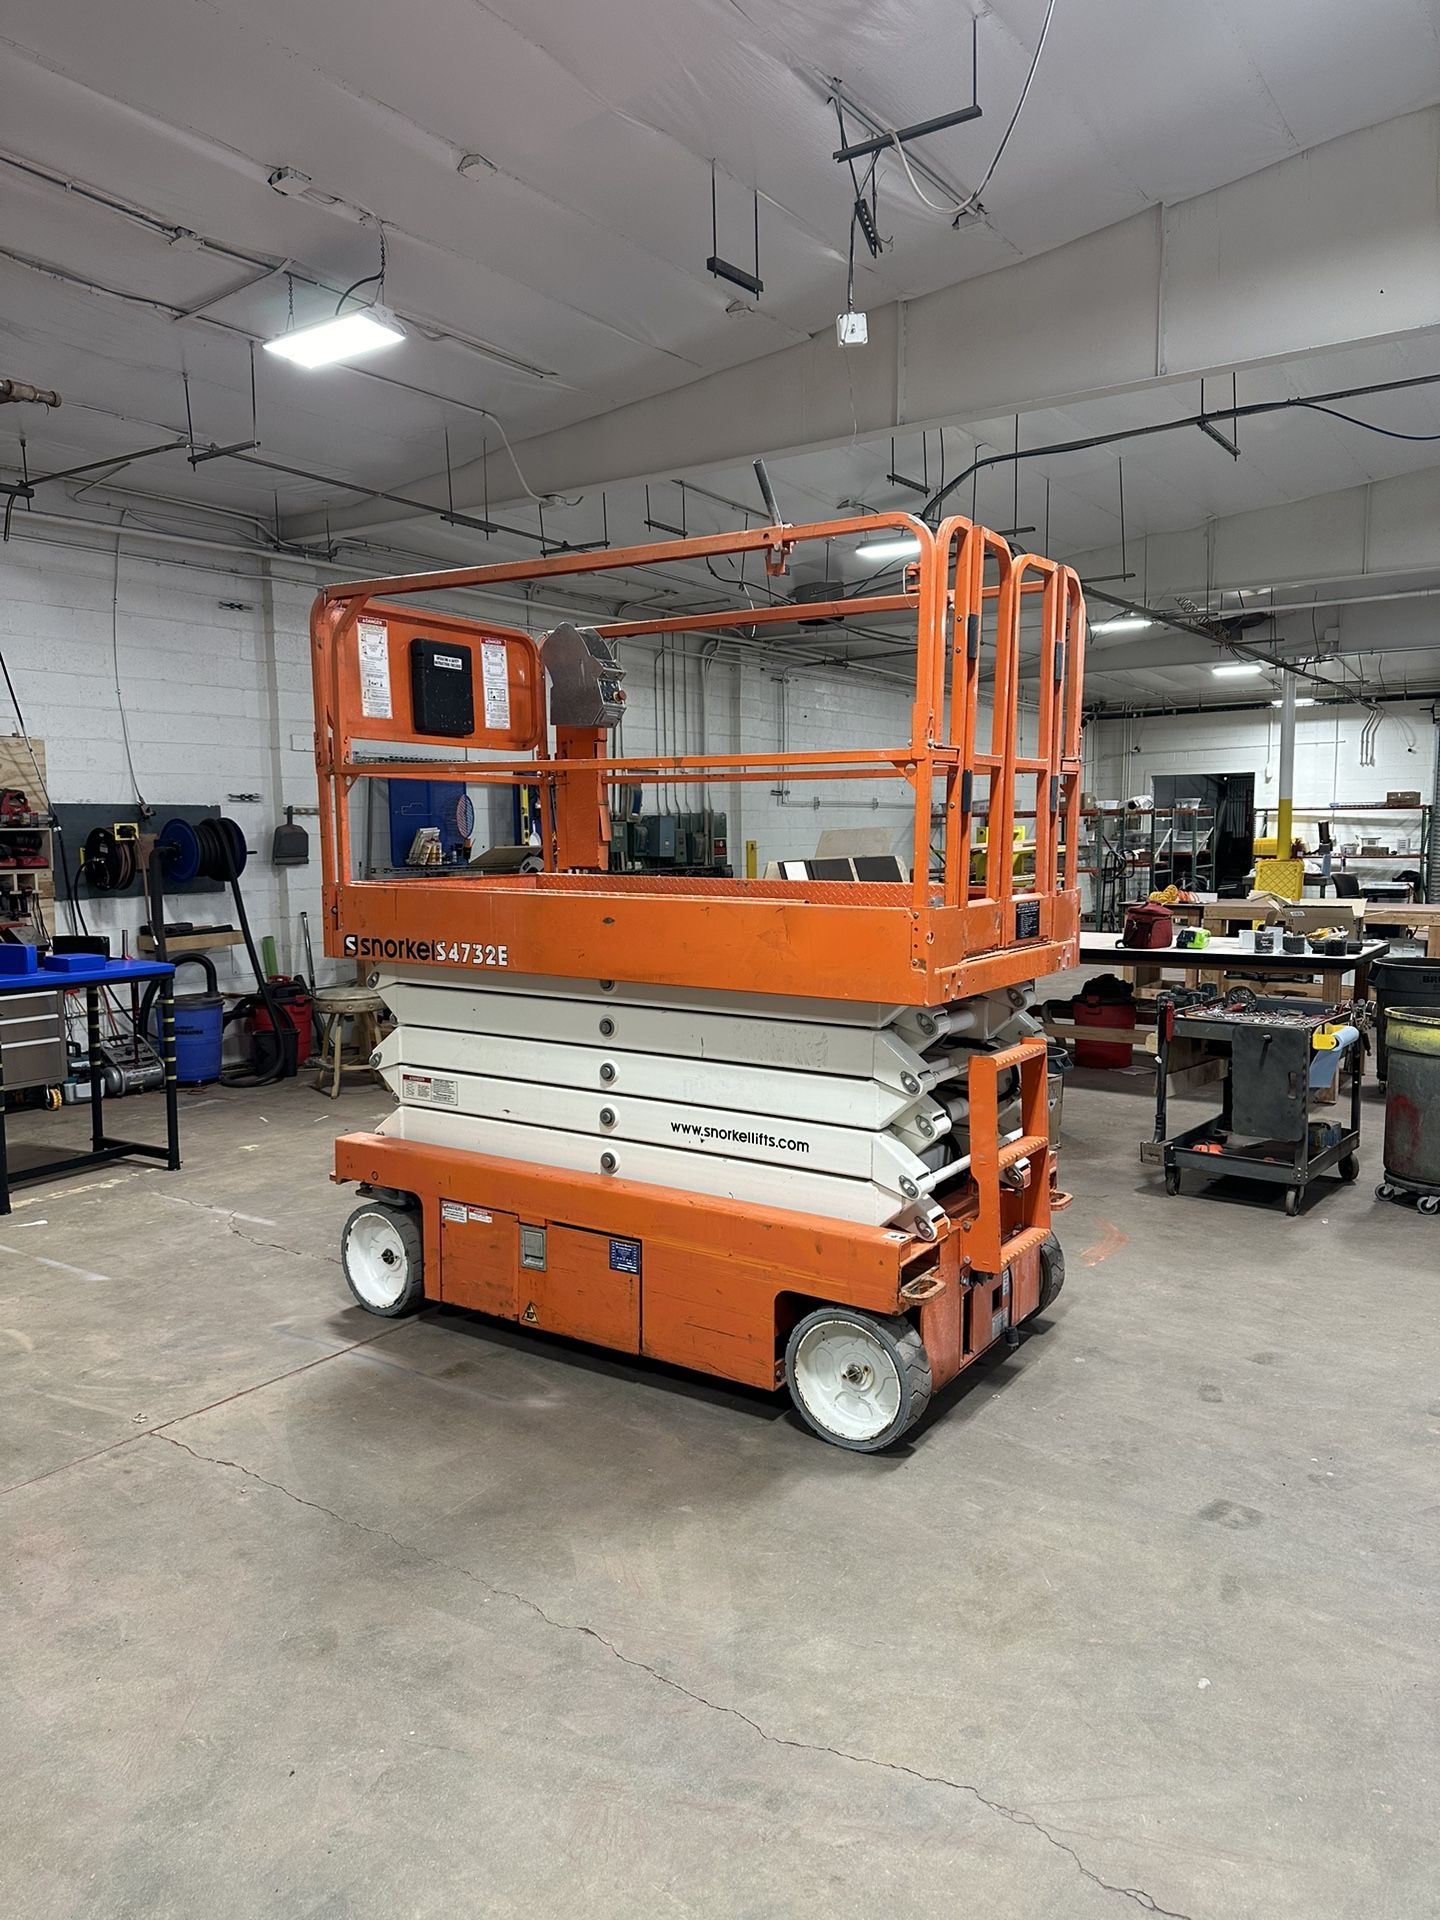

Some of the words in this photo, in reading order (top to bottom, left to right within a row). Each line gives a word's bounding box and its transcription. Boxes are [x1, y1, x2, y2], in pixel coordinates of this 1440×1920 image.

[361, 938, 436, 961] snorkel
[436, 941, 509, 966] S4732E
[671, 1122, 810, 1153] www.snorkellifts.com
